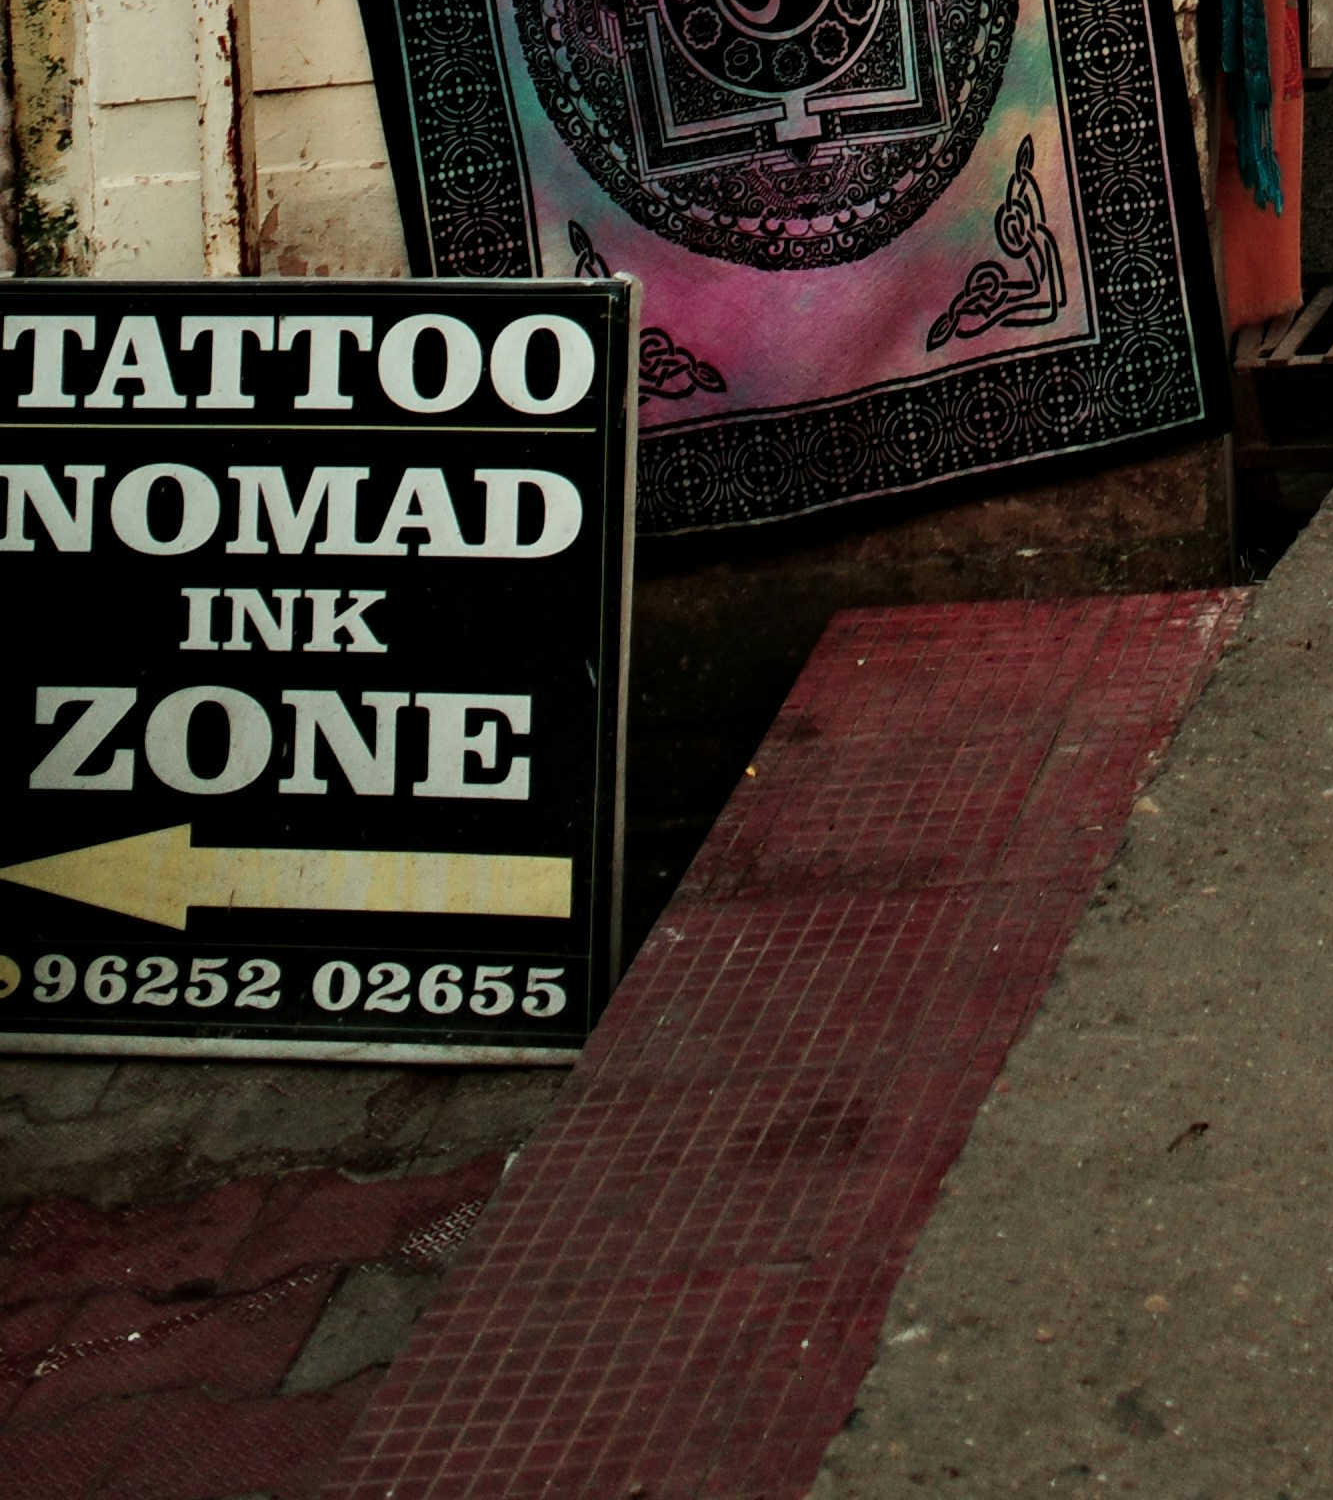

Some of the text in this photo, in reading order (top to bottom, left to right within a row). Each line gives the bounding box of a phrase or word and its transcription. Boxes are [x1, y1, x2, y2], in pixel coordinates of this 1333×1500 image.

[2, 314, 595, 414] TATTOO
[0, 462, 583, 559] NOMAD
[179, 588, 387, 652] INK
[29, 685, 531, 800] ZONE
[32, 955, 567, 1016] 96252 02655
